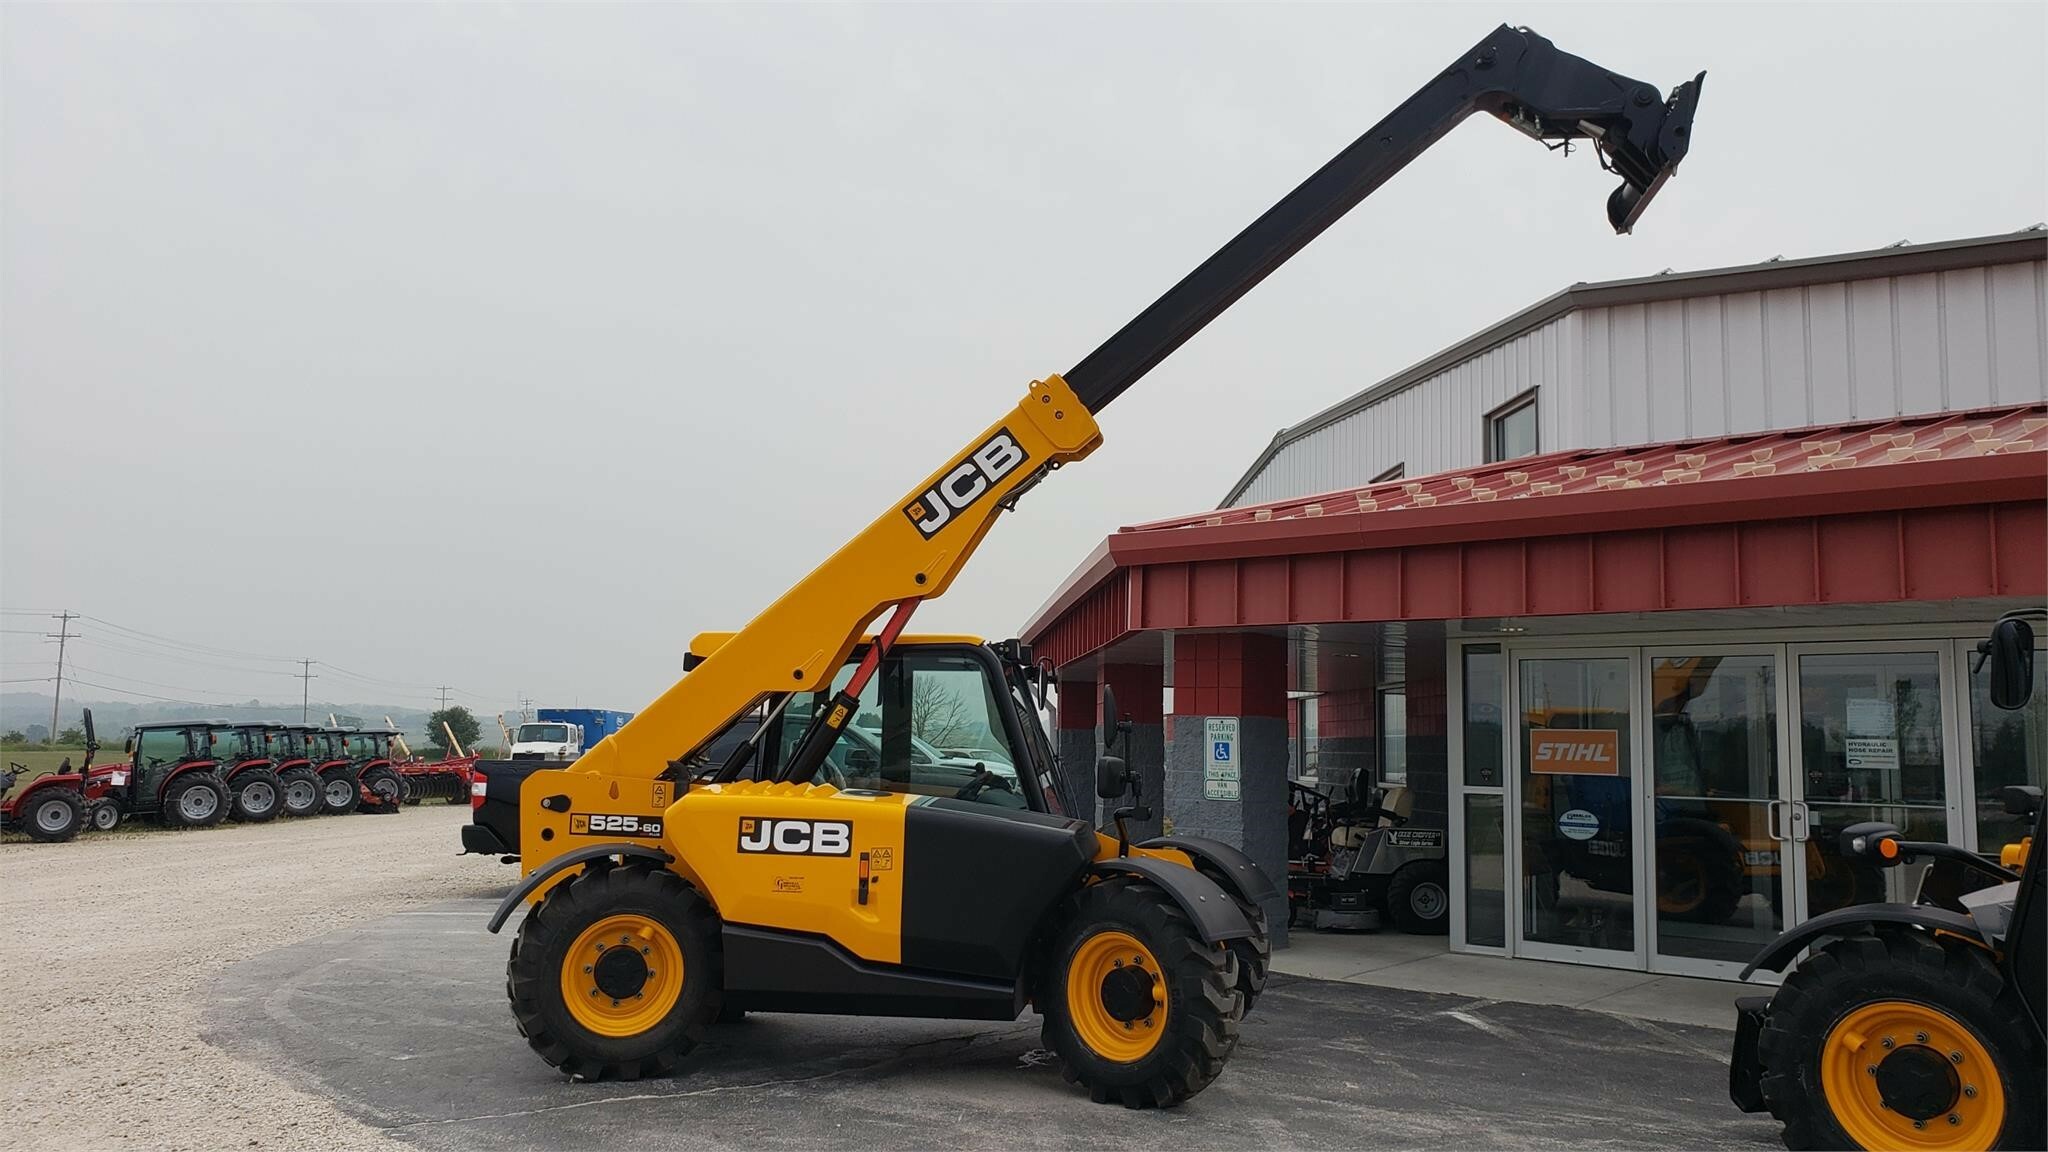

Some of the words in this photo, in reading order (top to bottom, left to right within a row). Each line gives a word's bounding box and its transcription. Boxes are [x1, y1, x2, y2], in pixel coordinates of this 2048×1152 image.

[918, 434, 1023, 533] JCB
[1208, 723, 1236, 732] RESERVED
[1210, 733, 1234, 741] PARKING
[1535, 742, 1611, 762] STIHL
[1207, 789, 1238, 797] ACCESSIBLE
[741, 820, 850, 854] JCB
